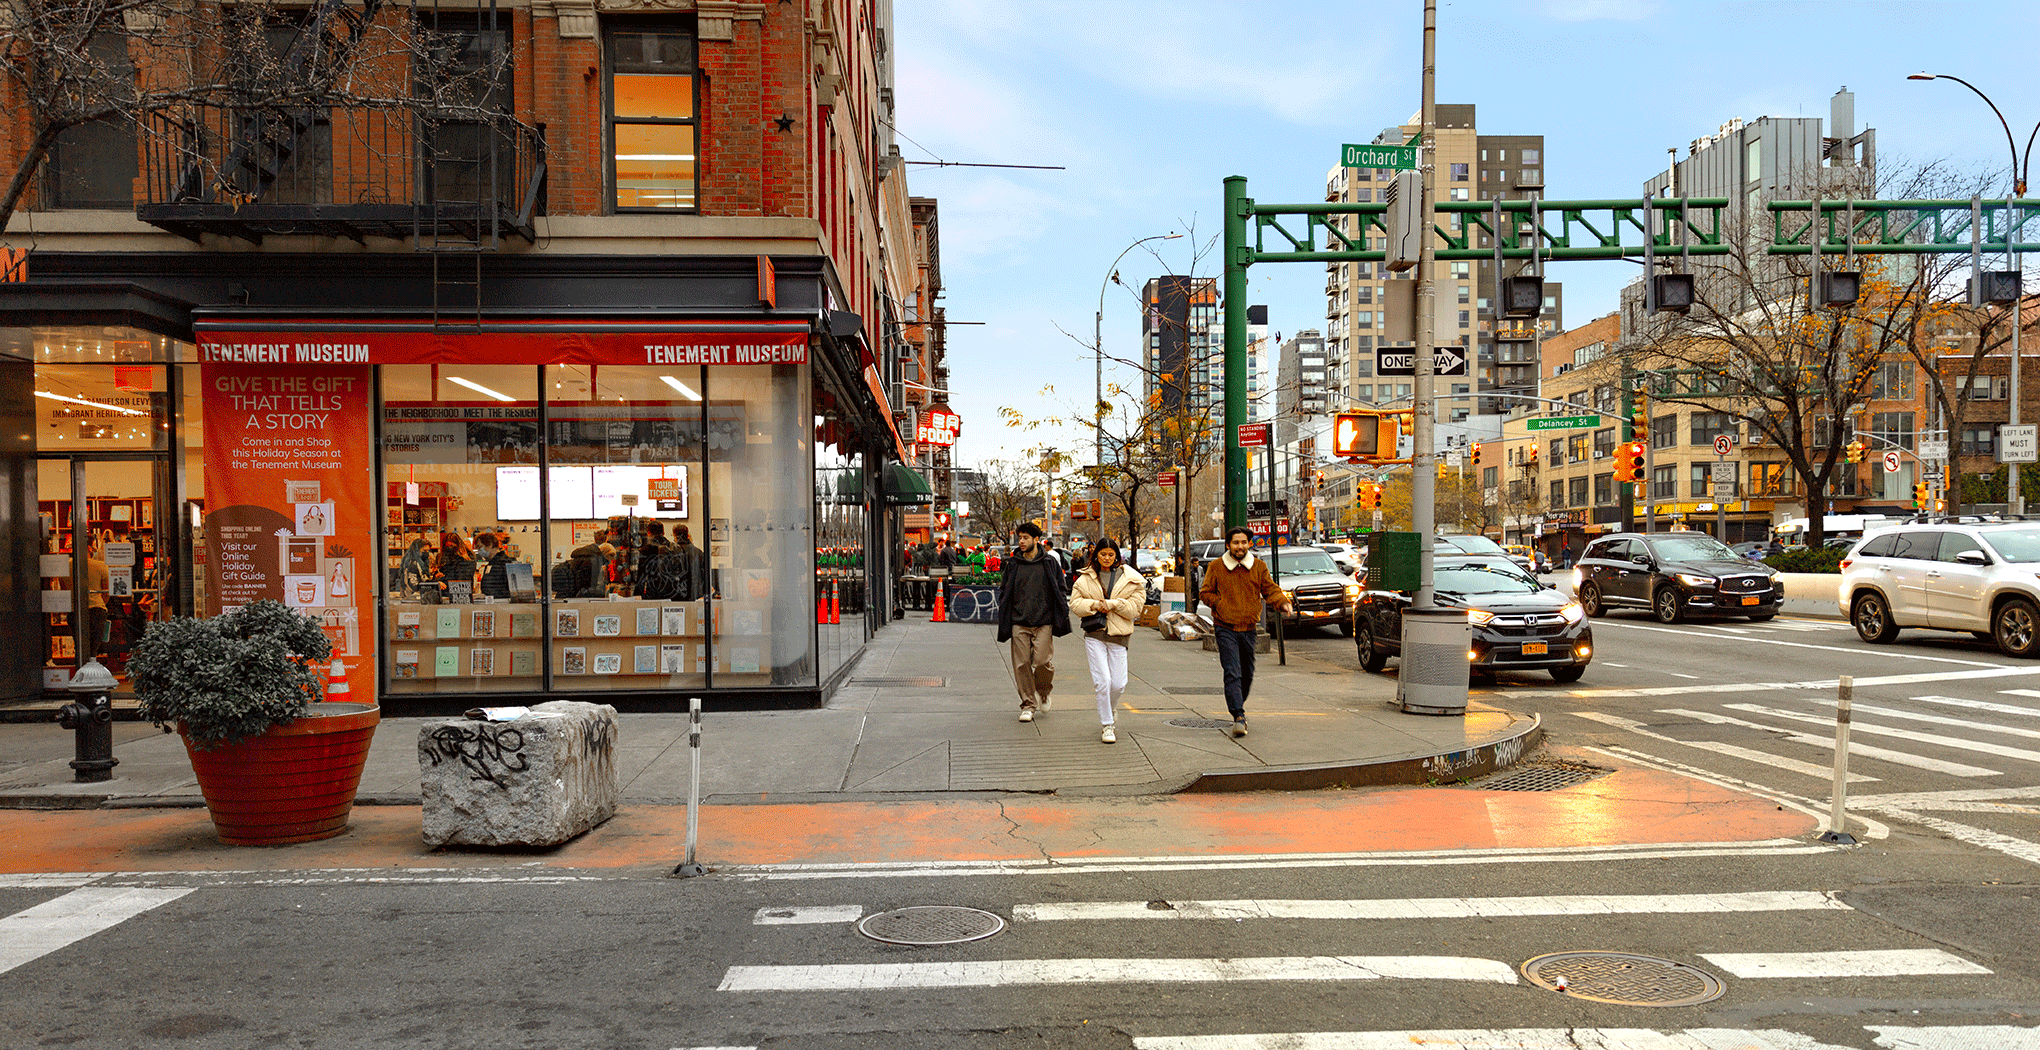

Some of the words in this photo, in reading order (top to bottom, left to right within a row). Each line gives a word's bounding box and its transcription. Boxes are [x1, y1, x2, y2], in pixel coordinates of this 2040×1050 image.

[1347, 146, 1398, 166] Orchard
[1404, 149, 1412, 160] St
[201, 343, 290, 362] TENEMENT
[295, 343, 369, 362] MUSEUM
[644, 344, 730, 364] TENEMENT
[736, 344, 804, 363] MUSEUM
[1384, 356, 1412, 367] ONE
[216, 376, 262, 392] GIVE
[267, 376, 306, 392] THE
[312, 376, 356, 392] GIFT
[132, 398, 150, 406] LEVY
[230, 396, 282, 410] THAT
[286, 396, 342, 410] TELLS
[52, 410, 94, 418] IMMIGRANT
[402, 408, 459, 418] NEIGHBORHOOD
[464, 408, 484, 418] MEET
[488, 408, 502, 418] THE
[245, 414, 260, 429] A
[266, 414, 328, 429] STORY
[920, 411, 960, 430] SEA
[1538, 420, 1574, 428] Delancey
[432, 434, 454, 442] CITY'S
[918, 426, 954, 444] FOOD
[242, 437, 271, 446] Come
[274, 437, 282, 446] in
[285, 437, 304, 446] and
[306, 437, 332, 448] Shop
[391, 444, 420, 452] STORIES
[232, 448, 250, 458] this
[253, 448, 290, 460] Holiday
[293, 448, 328, 458] Season
[331, 450, 341, 458] at
[232, 460, 248, 469] the
[250, 460, 299, 469] Tenement
[302, 460, 342, 469] Museum
[649, 490, 678, 498] TICKETS
[221, 542, 241, 550] Visit
[222, 552, 250, 560] Online
[222, 562, 255, 572] Holiday
[222, 572, 238, 580] Gift
[240, 572, 266, 580] Guide
